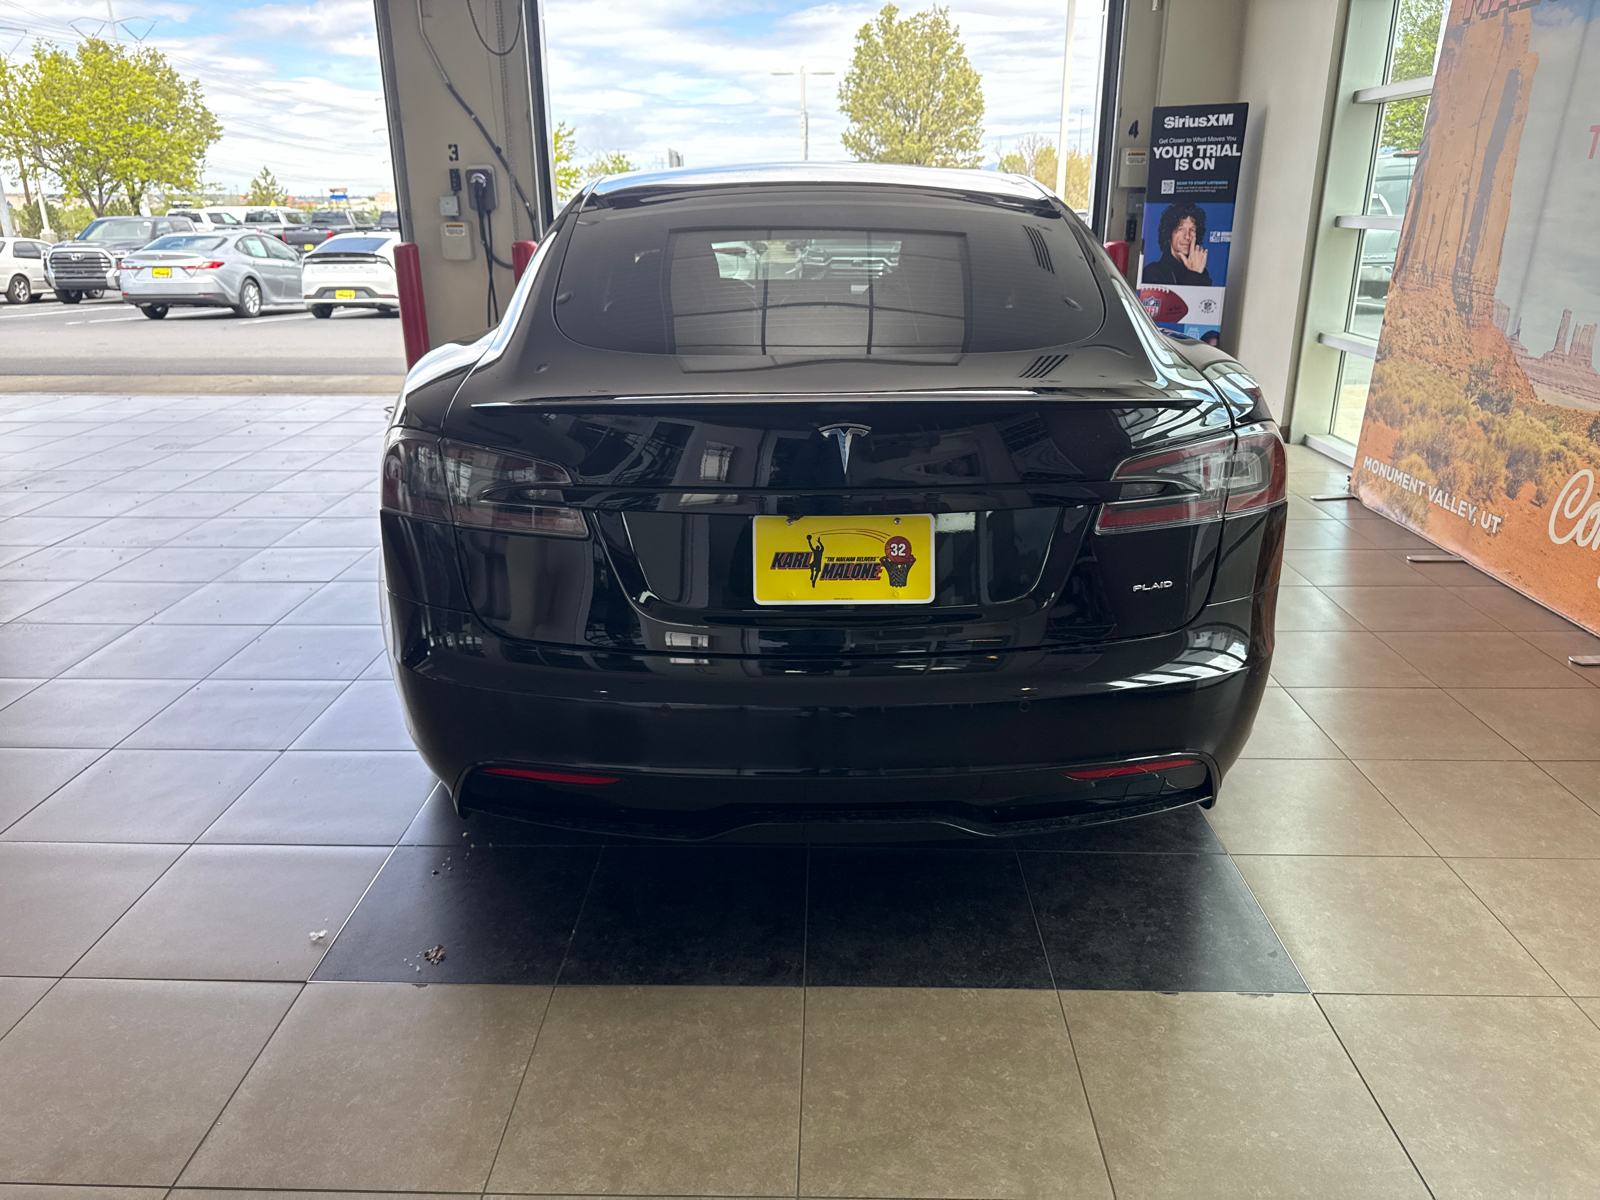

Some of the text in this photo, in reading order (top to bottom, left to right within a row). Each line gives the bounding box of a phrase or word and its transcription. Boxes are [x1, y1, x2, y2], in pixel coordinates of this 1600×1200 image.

[1128, 119, 1139, 139] 4
[1164, 113, 1234, 129] SiriusXM
[448, 144, 459, 161] 3
[1153, 144, 1241, 159] YOUR TRIAL
[1174, 158, 1216, 171] IS ON
[1363, 456, 1502, 534] MONUMENT VALLEY, UT
[1548, 468, 1600, 551] Co
[890, 543, 906, 557] 32
[770, 551, 813, 571] KARL
[819, 562, 883, 581] MALONE
[1133, 581, 1172, 592] PLAID
